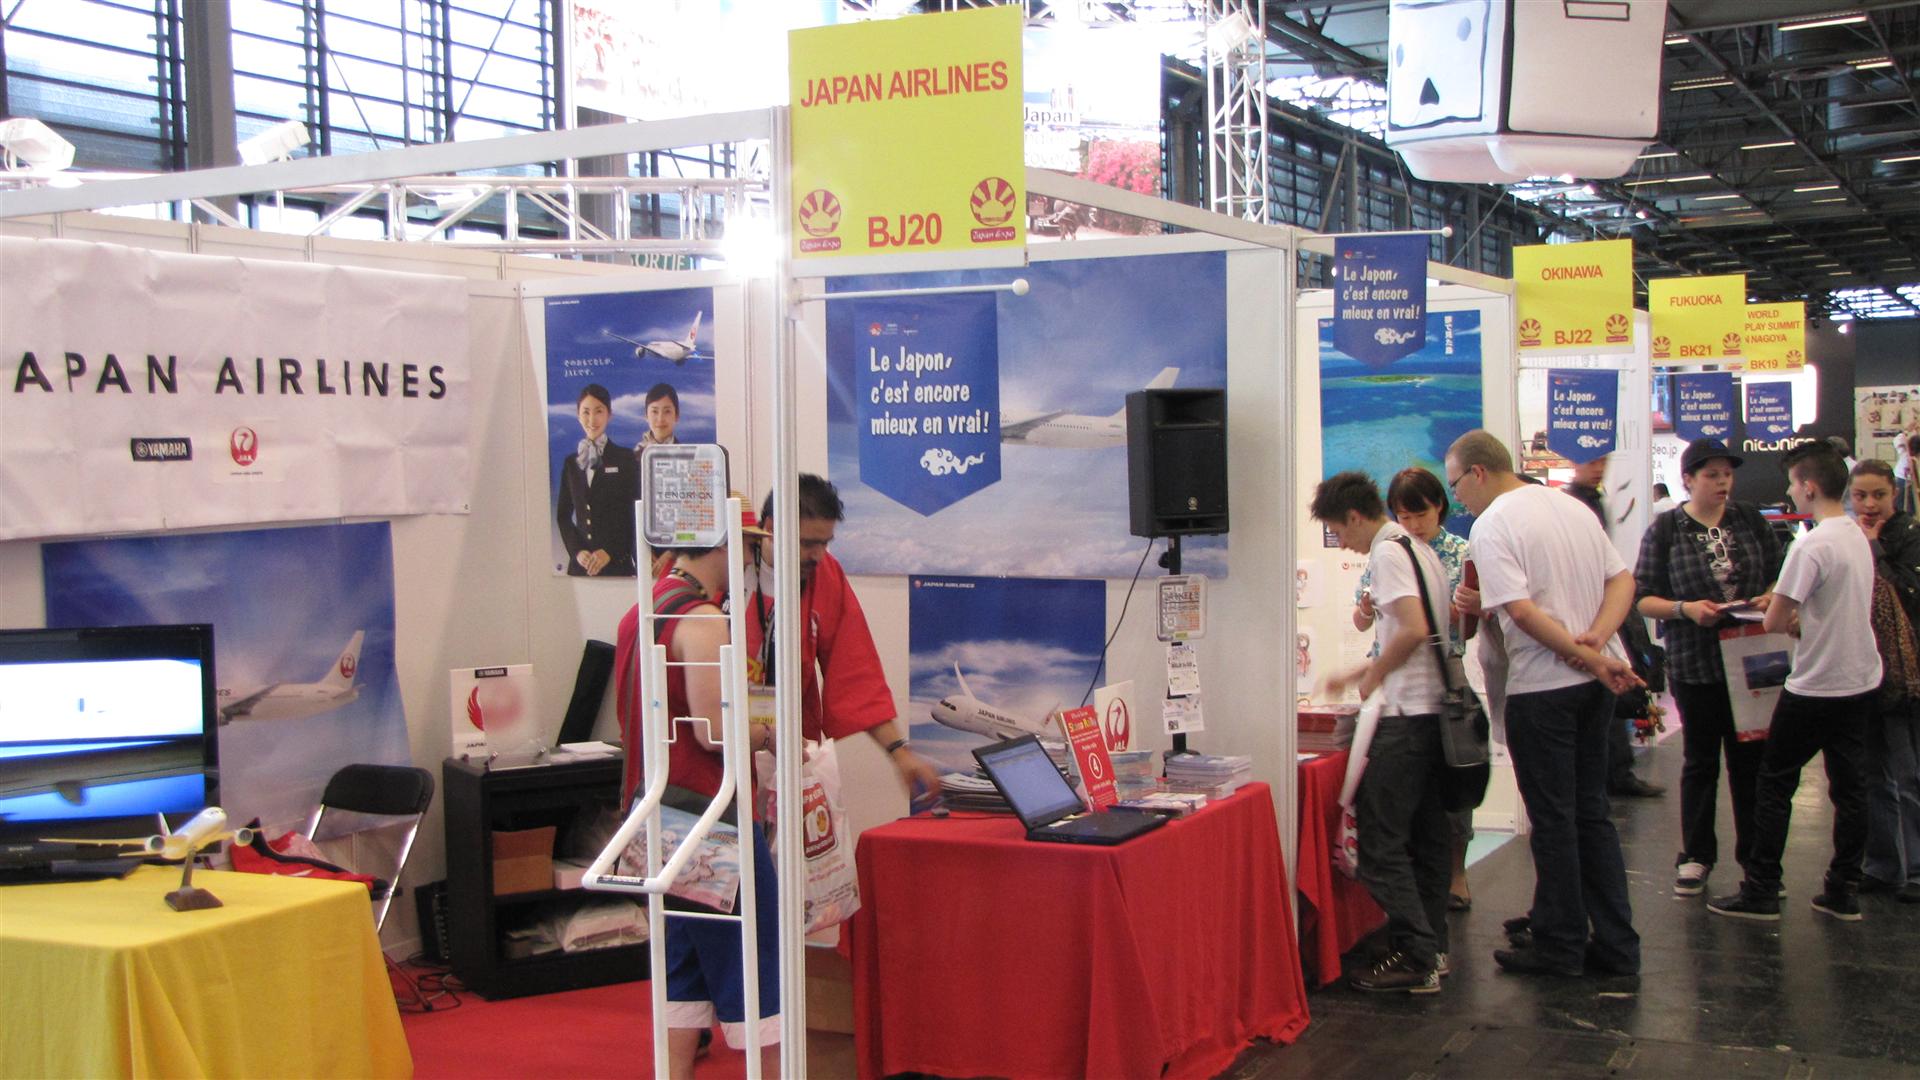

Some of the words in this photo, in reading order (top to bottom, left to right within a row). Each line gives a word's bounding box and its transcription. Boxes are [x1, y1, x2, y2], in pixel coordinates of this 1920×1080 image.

[801, 73, 882, 107] JAPAN
[888, 60, 1008, 99] AIRLINES
[868, 213, 942, 247] BJ20
[1343, 266, 1356, 282] Le
[1360, 265, 1398, 285] Japon,
[1541, 265, 1603, 280] OKINAWA
[1343, 287, 1368, 301] c'est
[1372, 288, 1409, 301] encore
[1670, 295, 1722, 306] FUKUOKA
[1342, 305, 1374, 321] mieux
[1377, 308, 1390, 319] en
[1393, 303, 1420, 320] vrai!
[1747, 310, 1779, 319] WORLD
[1744, 322, 1766, 331] PLAY
[1768, 321, 1800, 330] SUMMIT
[1555, 329, 1592, 345] BJ22
[1680, 345, 1712, 357] BK21
[870, 347, 890, 372] Le
[896, 346, 953, 378] Japon,
[1751, 359, 1778, 370] BK19
[215, 357, 447, 400] AIRLINES
[871, 379, 909, 404] c'est
[915, 384, 970, 403] encore
[871, 411, 918, 436] mieux
[923, 416, 943, 434] en
[948, 409, 990, 434] vrai!
[148, 442, 187, 456] YAMAHA
[1114, 740, 1127, 752] JAL
